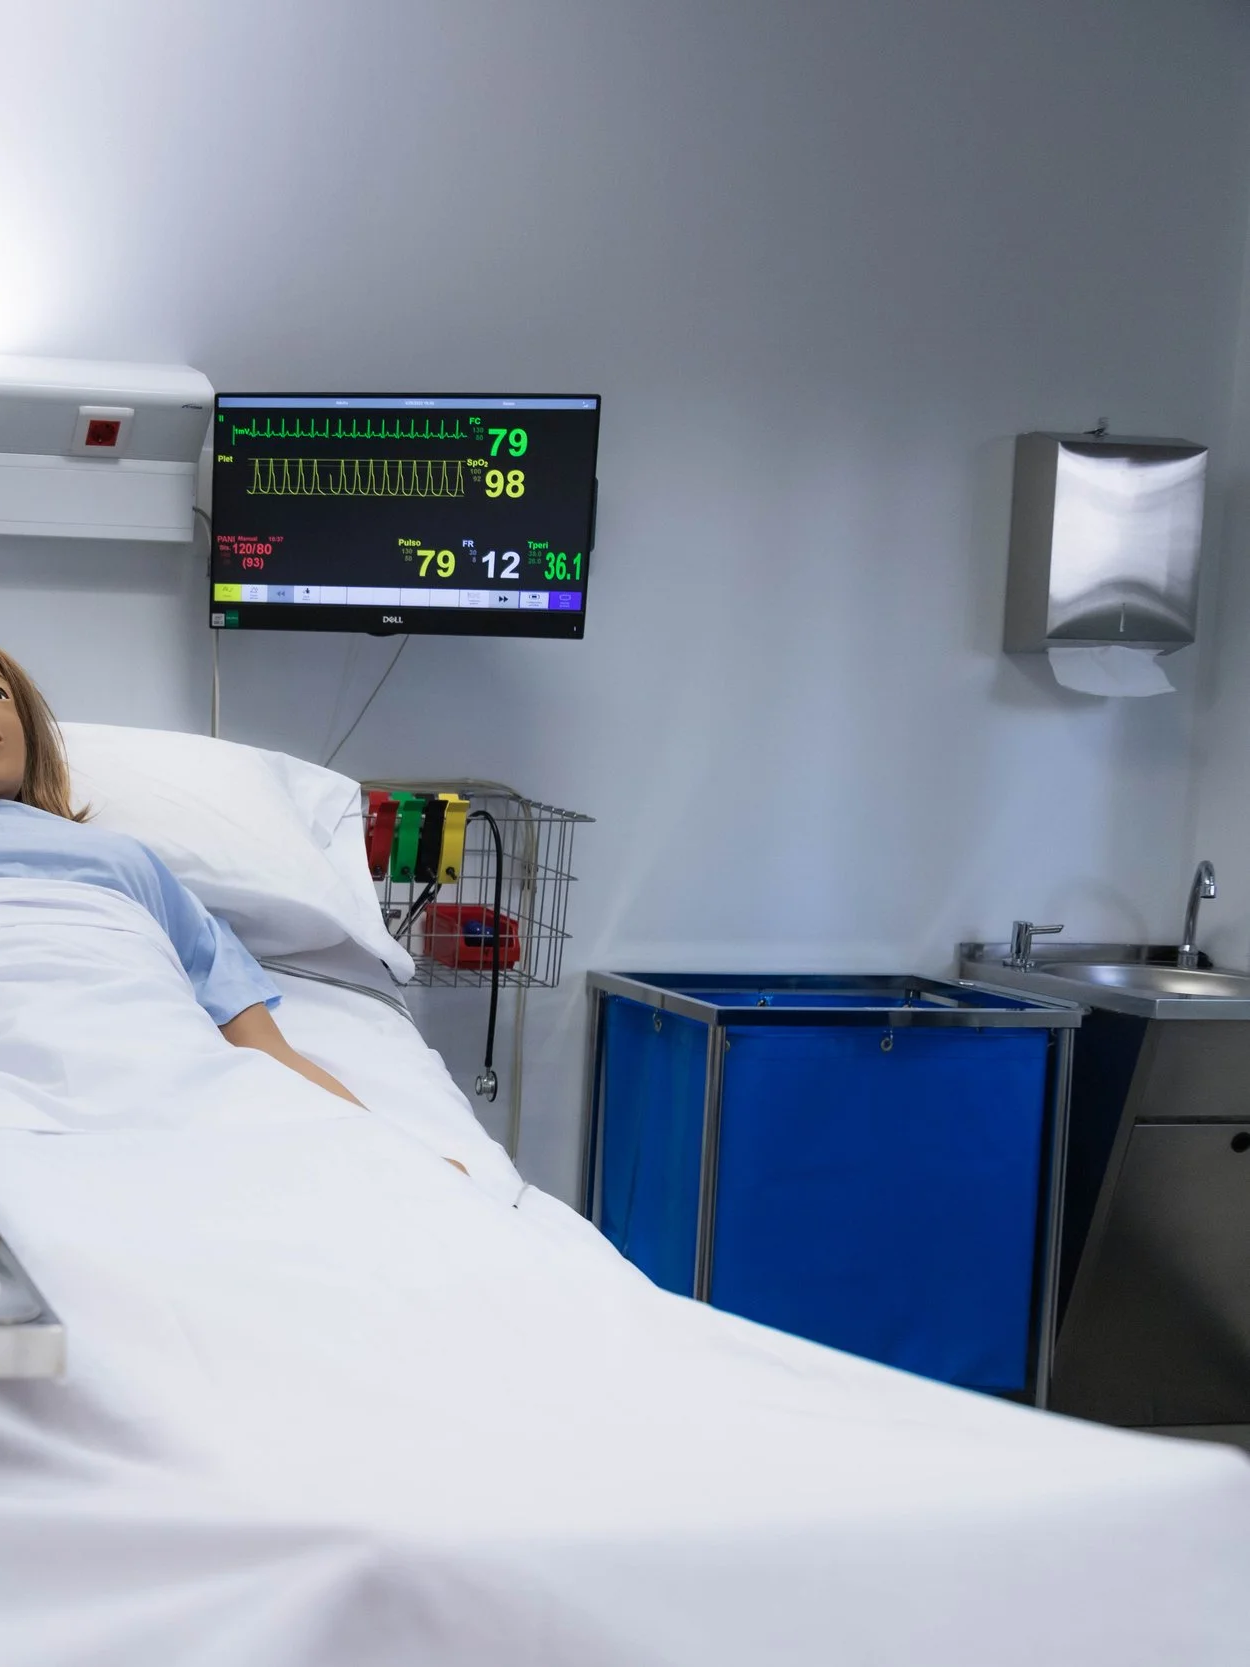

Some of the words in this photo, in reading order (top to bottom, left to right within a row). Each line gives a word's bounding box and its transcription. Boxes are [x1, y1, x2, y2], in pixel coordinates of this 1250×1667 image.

[469, 417, 481, 425] FC
[488, 428, 528, 457] 79
[217, 455, 233, 463] Plet
[485, 469, 525, 498] 98
[217, 535, 236, 543] PANI
[398, 538, 421, 547] Pulso
[462, 540, 474, 548] FR
[232, 543, 272, 555] 120/80
[527, 541, 549, 550] Tperi
[242, 557, 264, 570] (93)
[417, 549, 456, 578] 79
[481, 551, 521, 579] 12
[544, 552, 582, 580] 36.1
[383, 616, 403, 624] DELL
